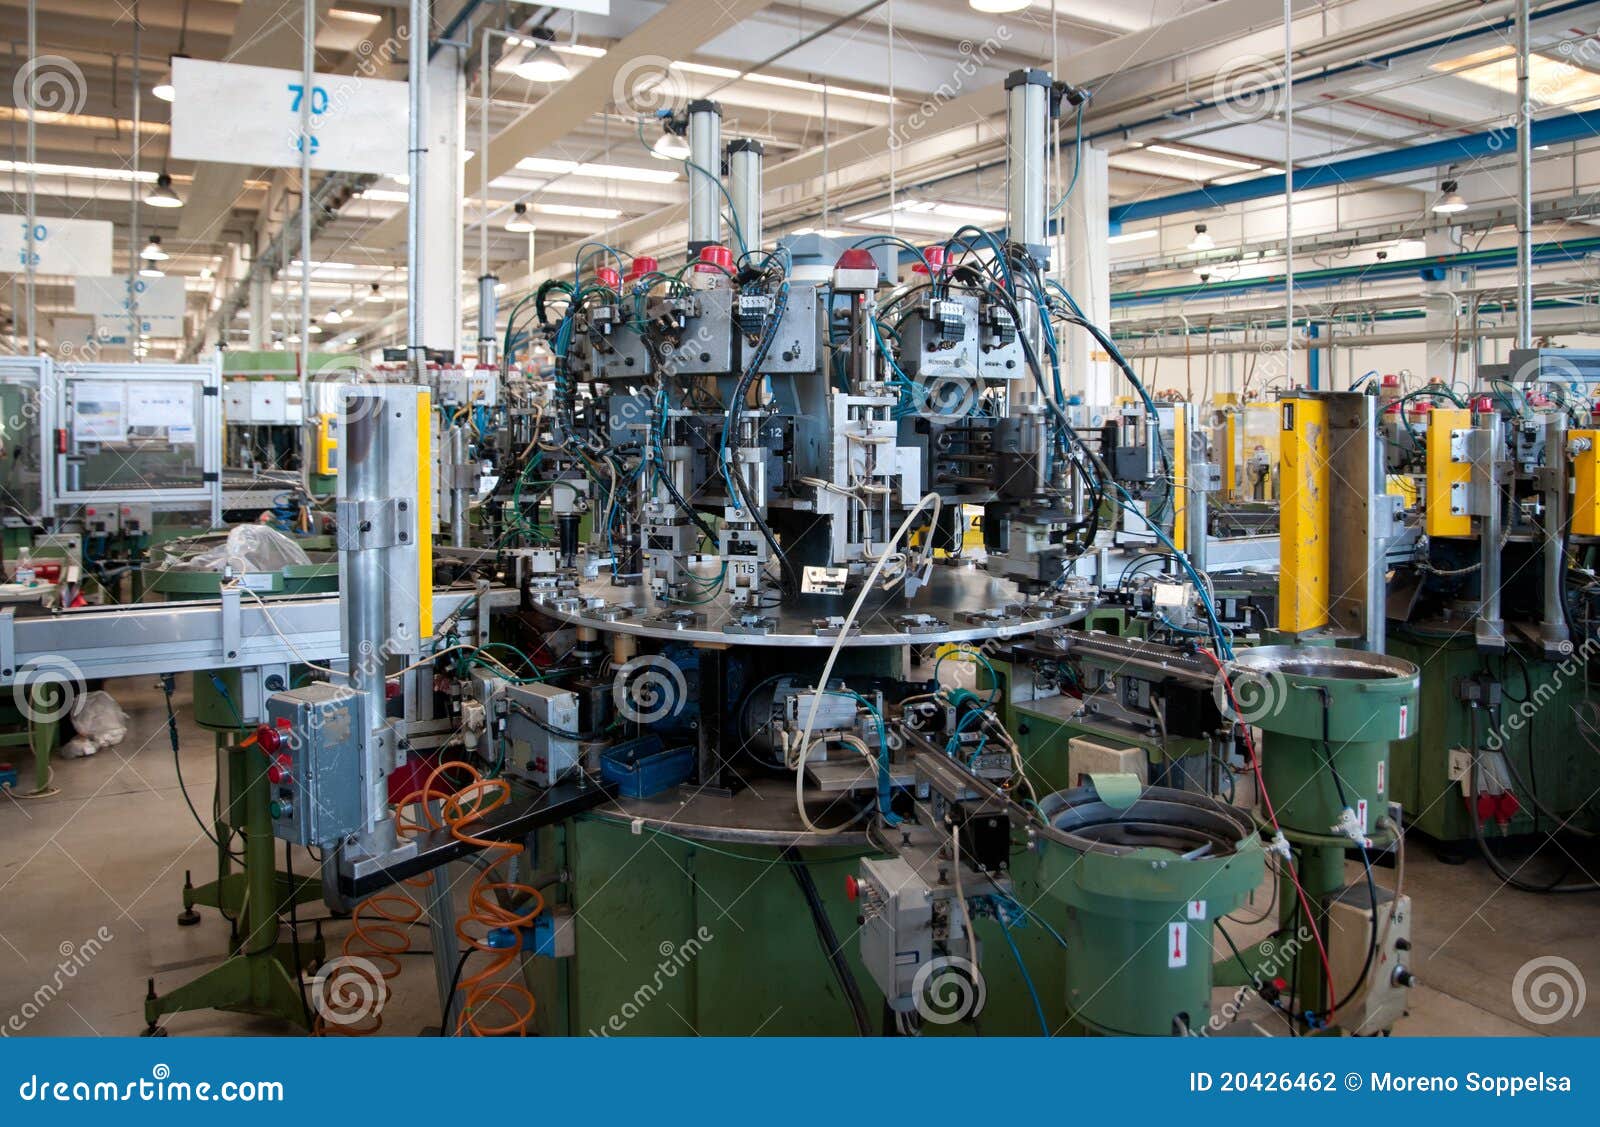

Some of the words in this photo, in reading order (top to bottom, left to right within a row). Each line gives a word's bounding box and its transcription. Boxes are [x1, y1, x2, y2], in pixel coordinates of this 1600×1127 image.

[287, 84, 329, 115] 70
[770, 427, 782, 438] 12
[734, 563, 755, 574] 115
